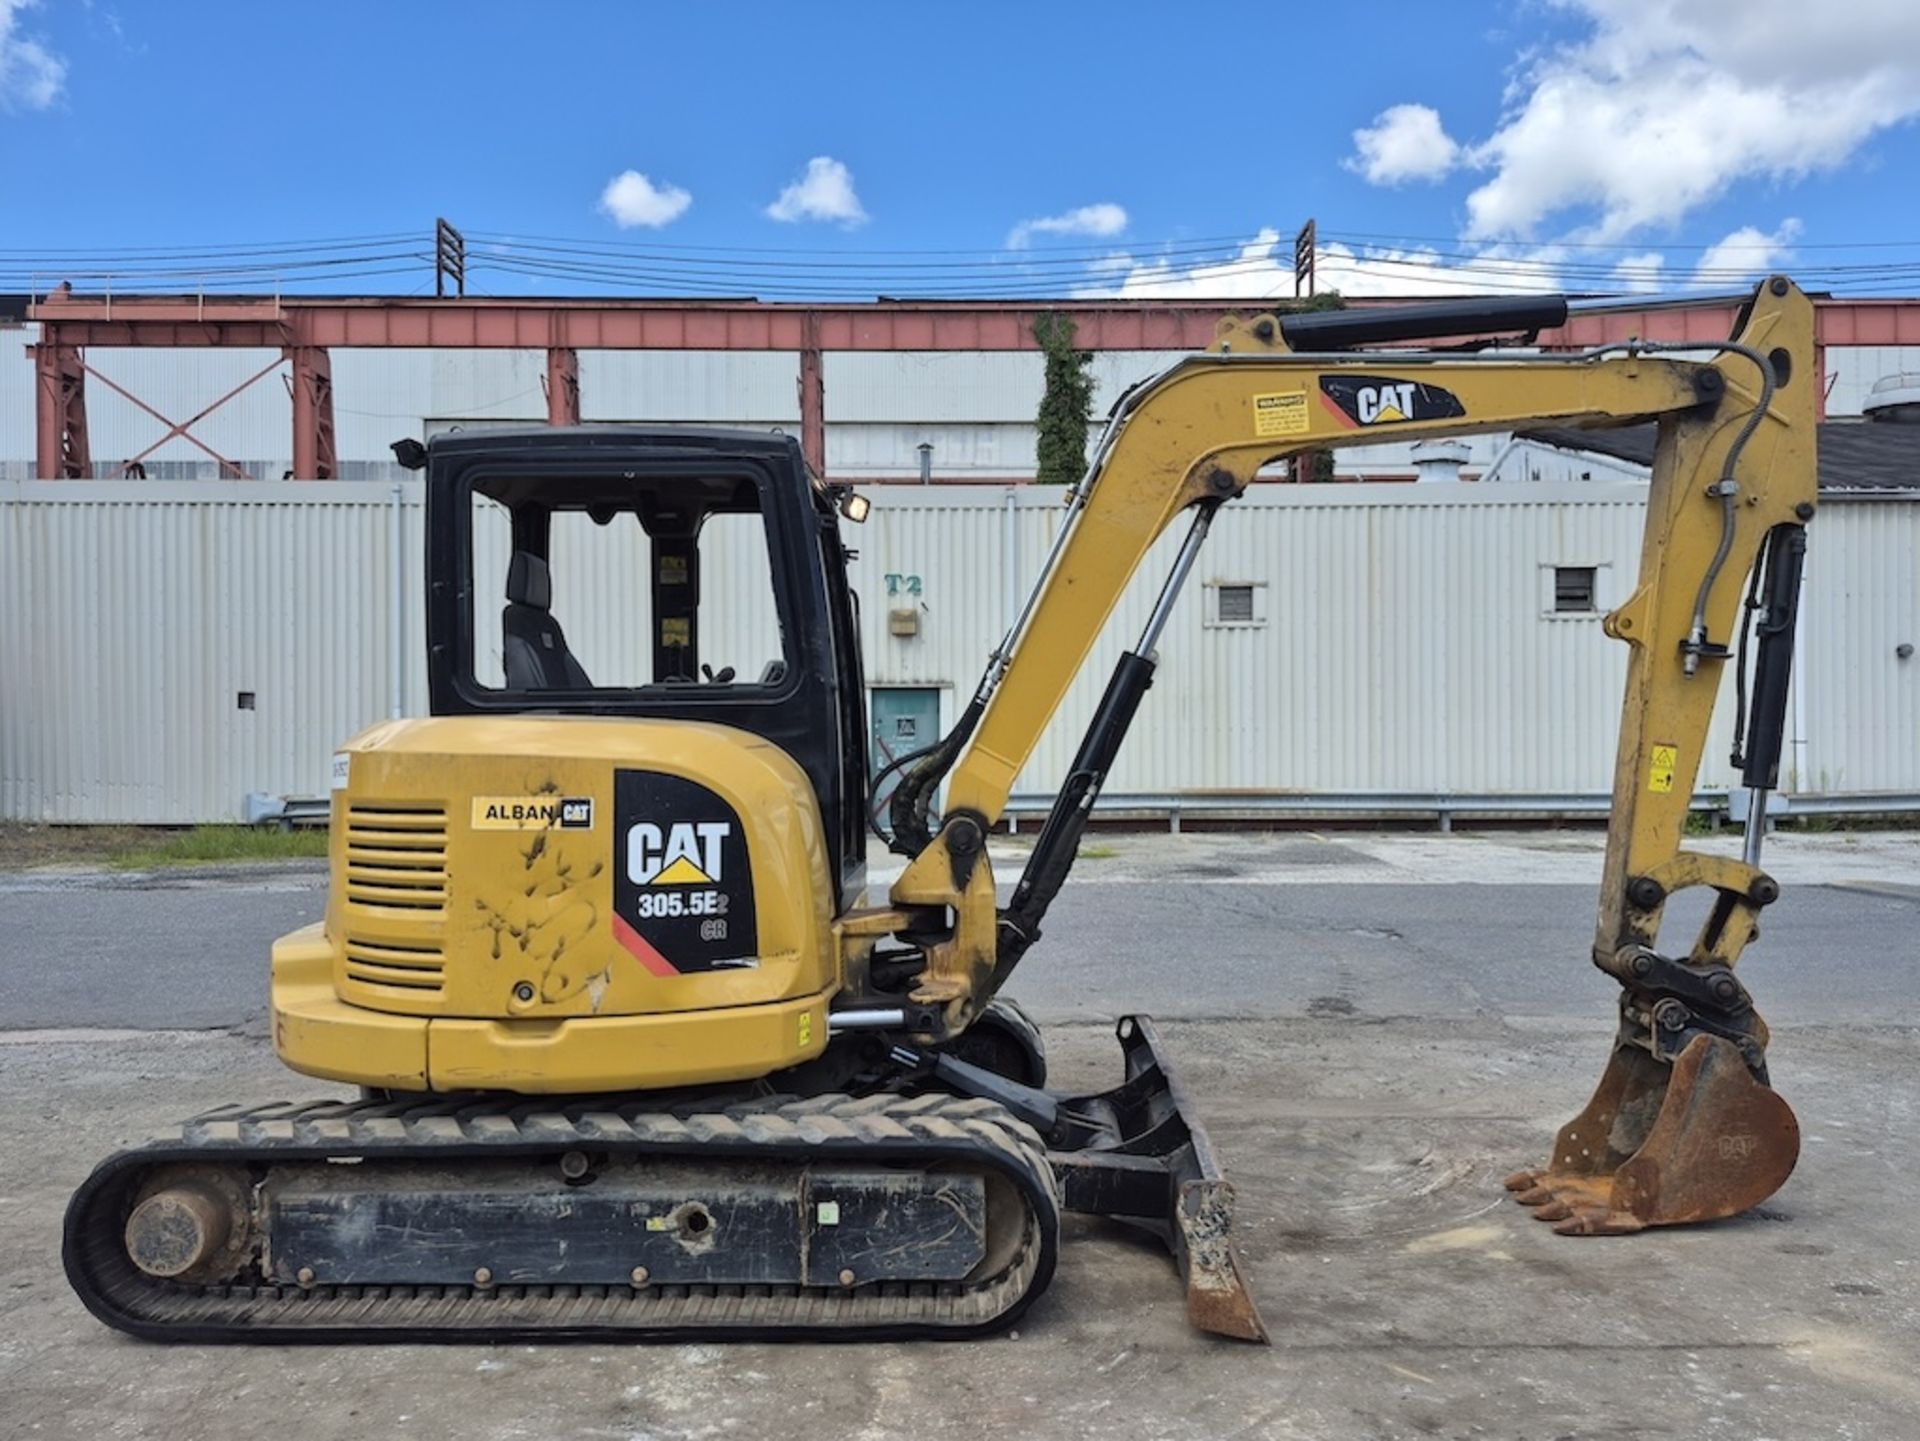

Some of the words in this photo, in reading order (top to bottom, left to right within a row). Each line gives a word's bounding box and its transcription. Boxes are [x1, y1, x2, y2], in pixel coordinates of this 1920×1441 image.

[1357, 383, 1416, 424] CAT
[884, 573, 922, 596] T2
[485, 804, 554, 820] ALBAN
[563, 803, 590, 821] CAT
[627, 822, 730, 885] CAT
[638, 890, 730, 918] 305.5E2
[700, 918, 728, 941] CR
